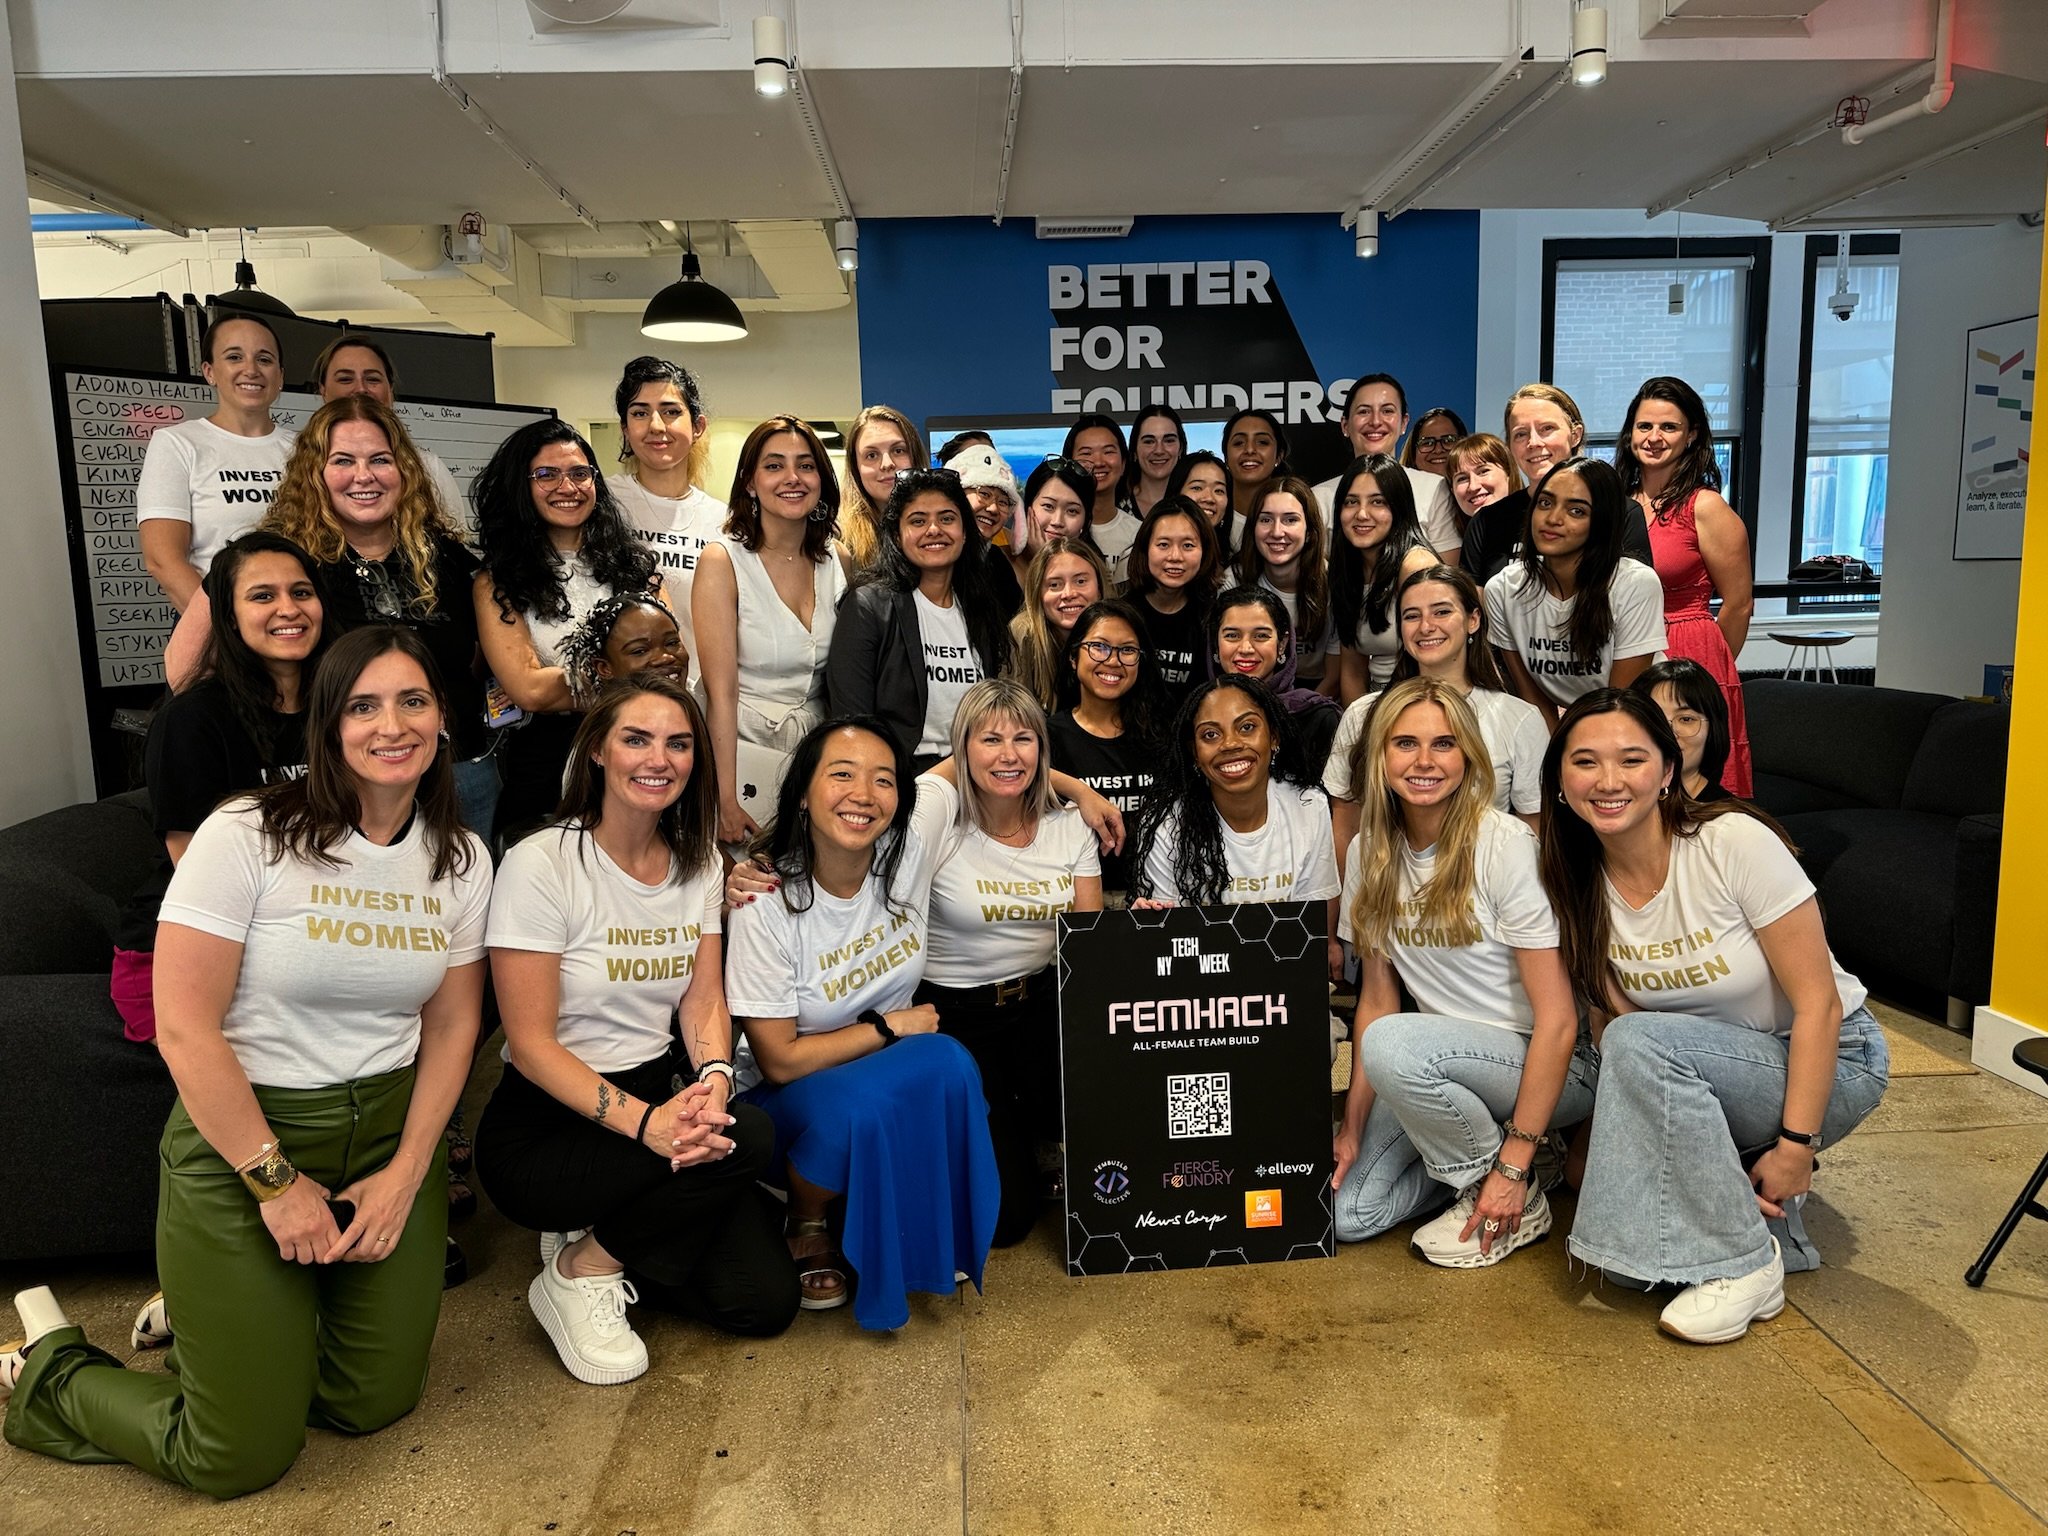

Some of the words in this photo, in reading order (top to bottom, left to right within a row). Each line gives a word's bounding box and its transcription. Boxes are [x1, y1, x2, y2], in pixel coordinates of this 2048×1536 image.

[1048, 259, 1272, 310] BETTER
[1050, 325, 1165, 371] FOR
[75, 374, 144, 396] ADOMO
[149, 381, 212, 401] HEALTH
[219, 470, 281, 482] INVEST
[1967, 491, 1998, 501] Analyze,
[1989, 501, 1995, 510] &
[94, 511, 138, 529] OFF
[632, 529, 689, 546] NVEST
[107, 608, 156, 625] SEEK
[1529, 637, 1571, 652] INVES
[1078, 775, 1133, 789] NVEST
[976, 879, 1051, 896] INVEST
[1057, 872, 1072, 891] IN
[1276, 872, 1293, 888] IN
[310, 884, 414, 912] INVEST
[423, 895, 441, 915] IN
[306, 916, 449, 951] WOMEN
[607, 926, 677, 946] INVEST
[682, 923, 701, 942] IN
[818, 924, 885, 971] INVEST
[890, 909, 909, 933] IN
[1611, 938, 1685, 961] INVEST
[1688, 927, 1714, 951] IN
[822, 932, 921, 1002] WOMEN
[1157, 956, 1172, 976] NY
[1171, 937, 1199, 957] TECH
[1199, 953, 1230, 974] WEEK
[1618, 954, 1731, 992] WOMEN
[1108, 993, 1288, 1034] FEMHACK
[1133, 1038, 1195, 1051] ALL-FEMALE
[1197, 1037, 1226, 1047] TEAM
[1229, 1035, 1259, 1046] BUILD
[1094, 1160, 1128, 1173] FEMBUILD
[1174, 1160, 1220, 1174] FIERCE
[1268, 1162, 1314, 1175] ellevoy
[1163, 1168, 1235, 1189] FOUNDRY
[1093, 1190, 1131, 1205] COLLECTIVE
[1135, 1210, 1181, 1228] News
[1184, 1210, 1227, 1231] Corp
